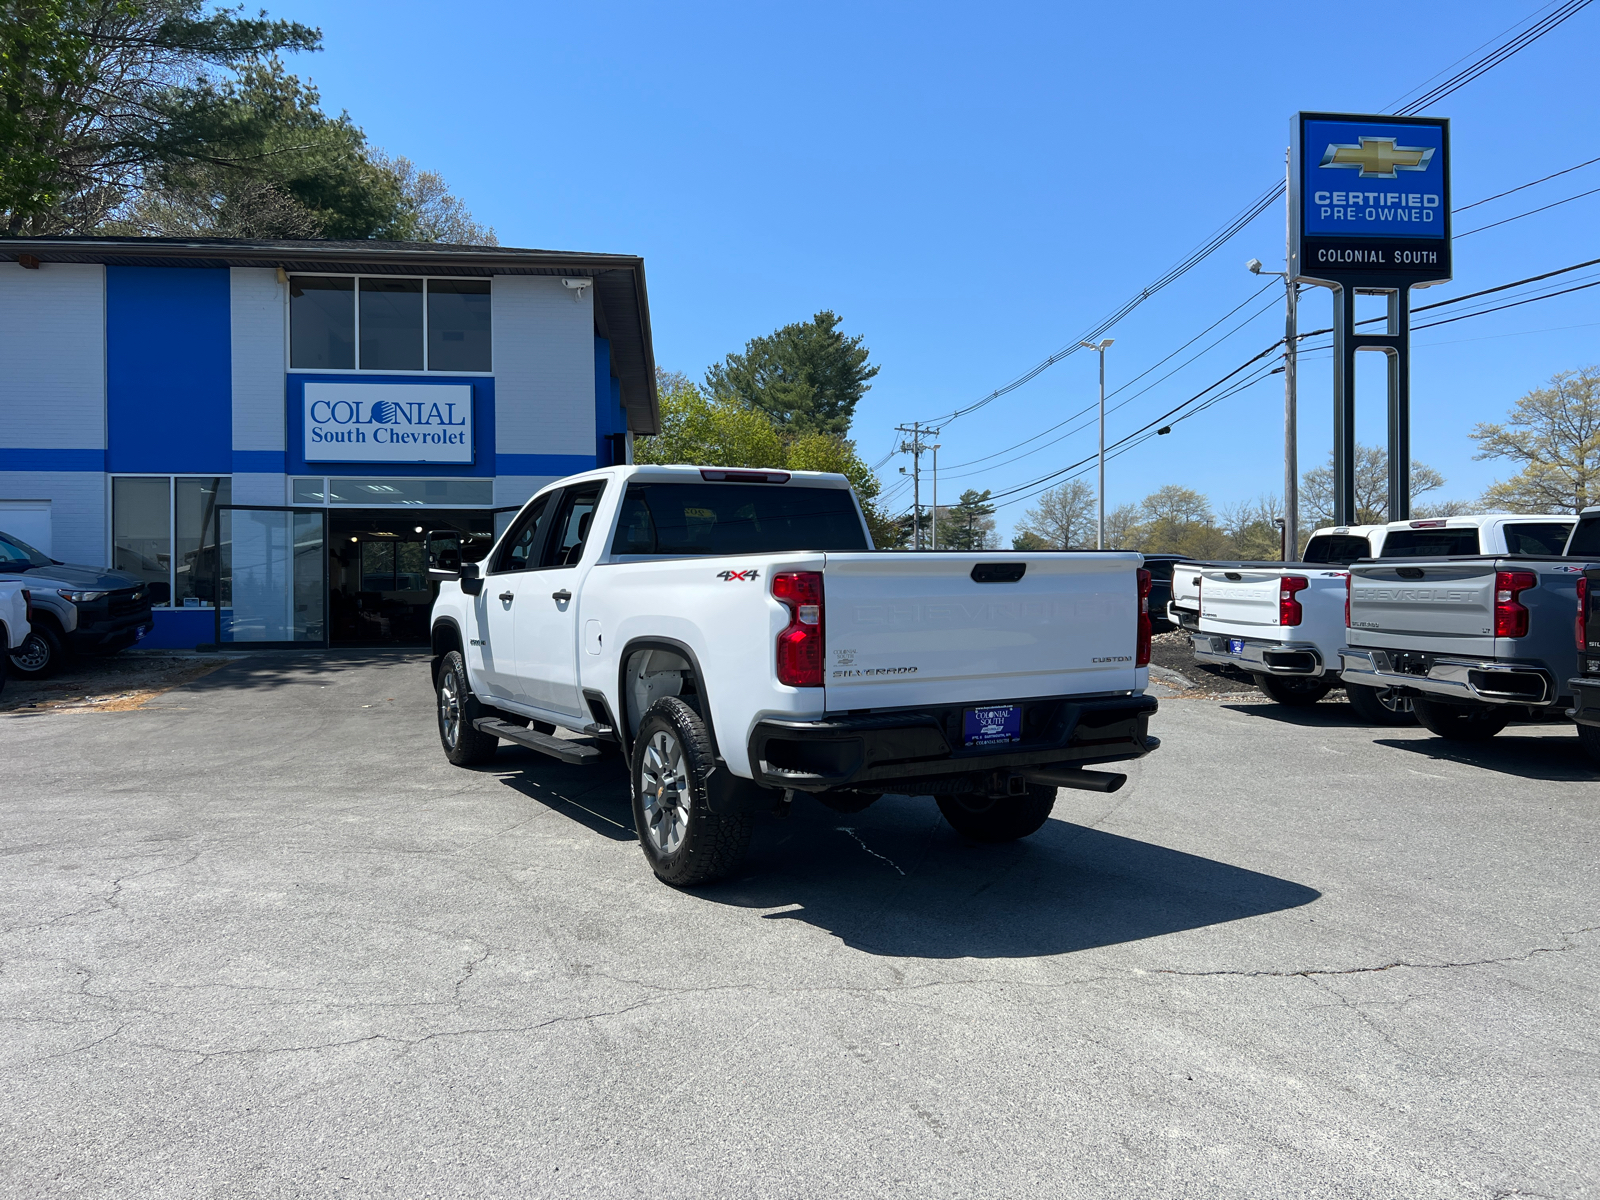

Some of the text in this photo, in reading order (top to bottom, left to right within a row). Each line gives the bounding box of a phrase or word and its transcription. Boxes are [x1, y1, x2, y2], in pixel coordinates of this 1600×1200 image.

[1314, 191, 1440, 207] CERTIFIED
[1320, 207, 1434, 222] PRE-OWNED
[1318, 249, 1437, 263] COLONIAL SOUTH
[310, 400, 466, 426] COLONIAL
[311, 426, 466, 444] South Chevrolet
[1354, 589, 1480, 602] CHEVROLET
[832, 666, 918, 678] SILVERADO
[975, 710, 1010, 719] COLONIAL
